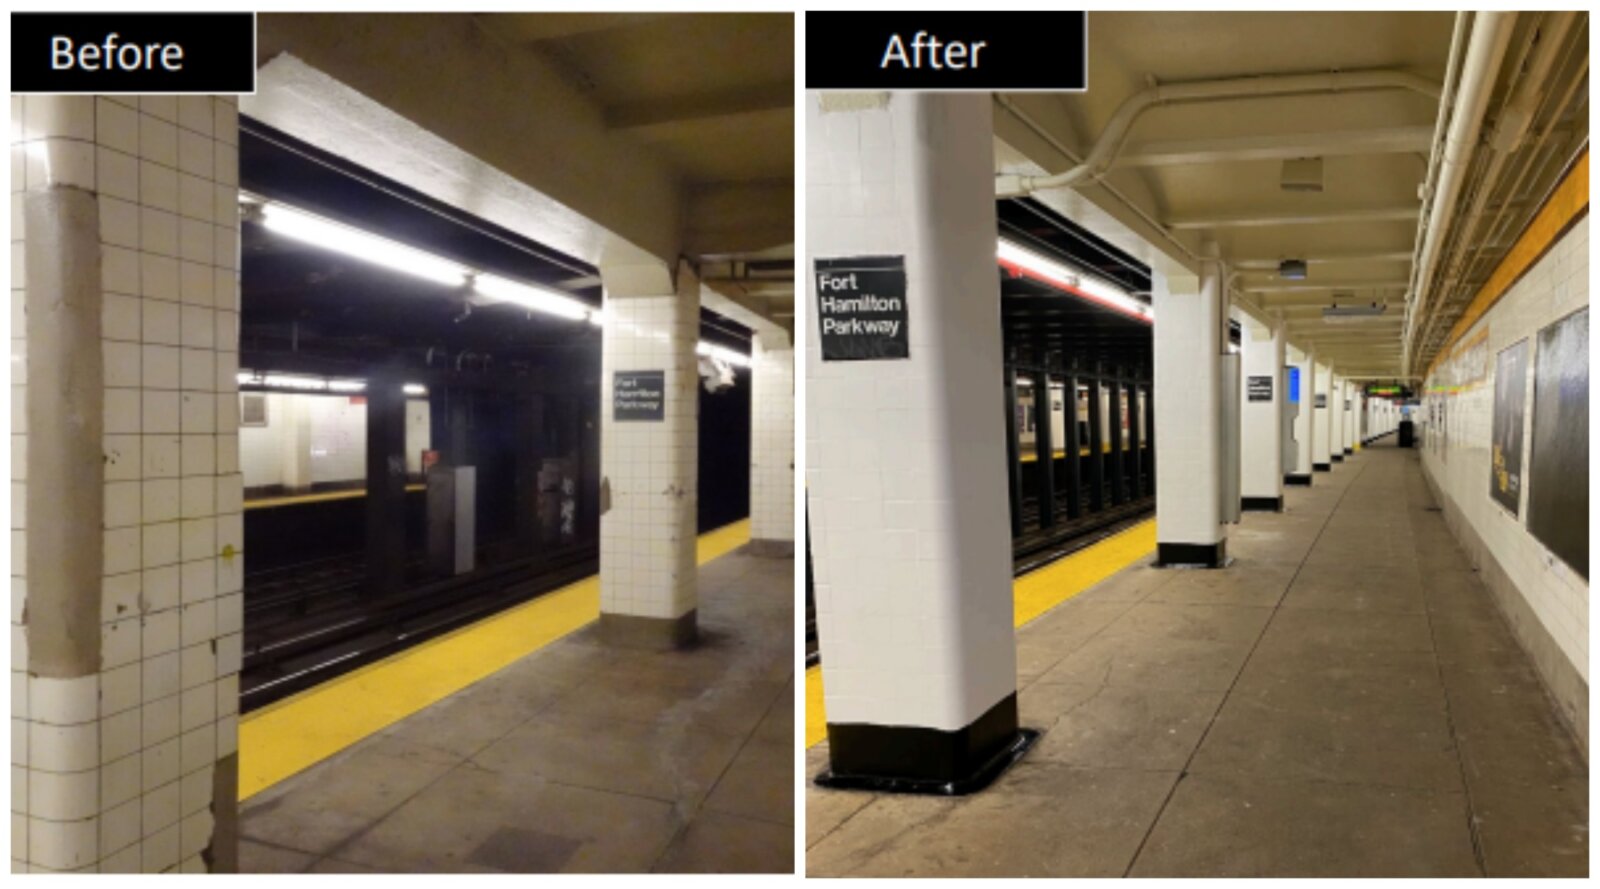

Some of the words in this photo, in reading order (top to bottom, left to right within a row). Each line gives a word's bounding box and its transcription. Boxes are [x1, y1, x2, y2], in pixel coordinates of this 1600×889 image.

[820, 272, 859, 291] Fort
[820, 294, 902, 313] Hamilton
[822, 317, 900, 337] Parkway
